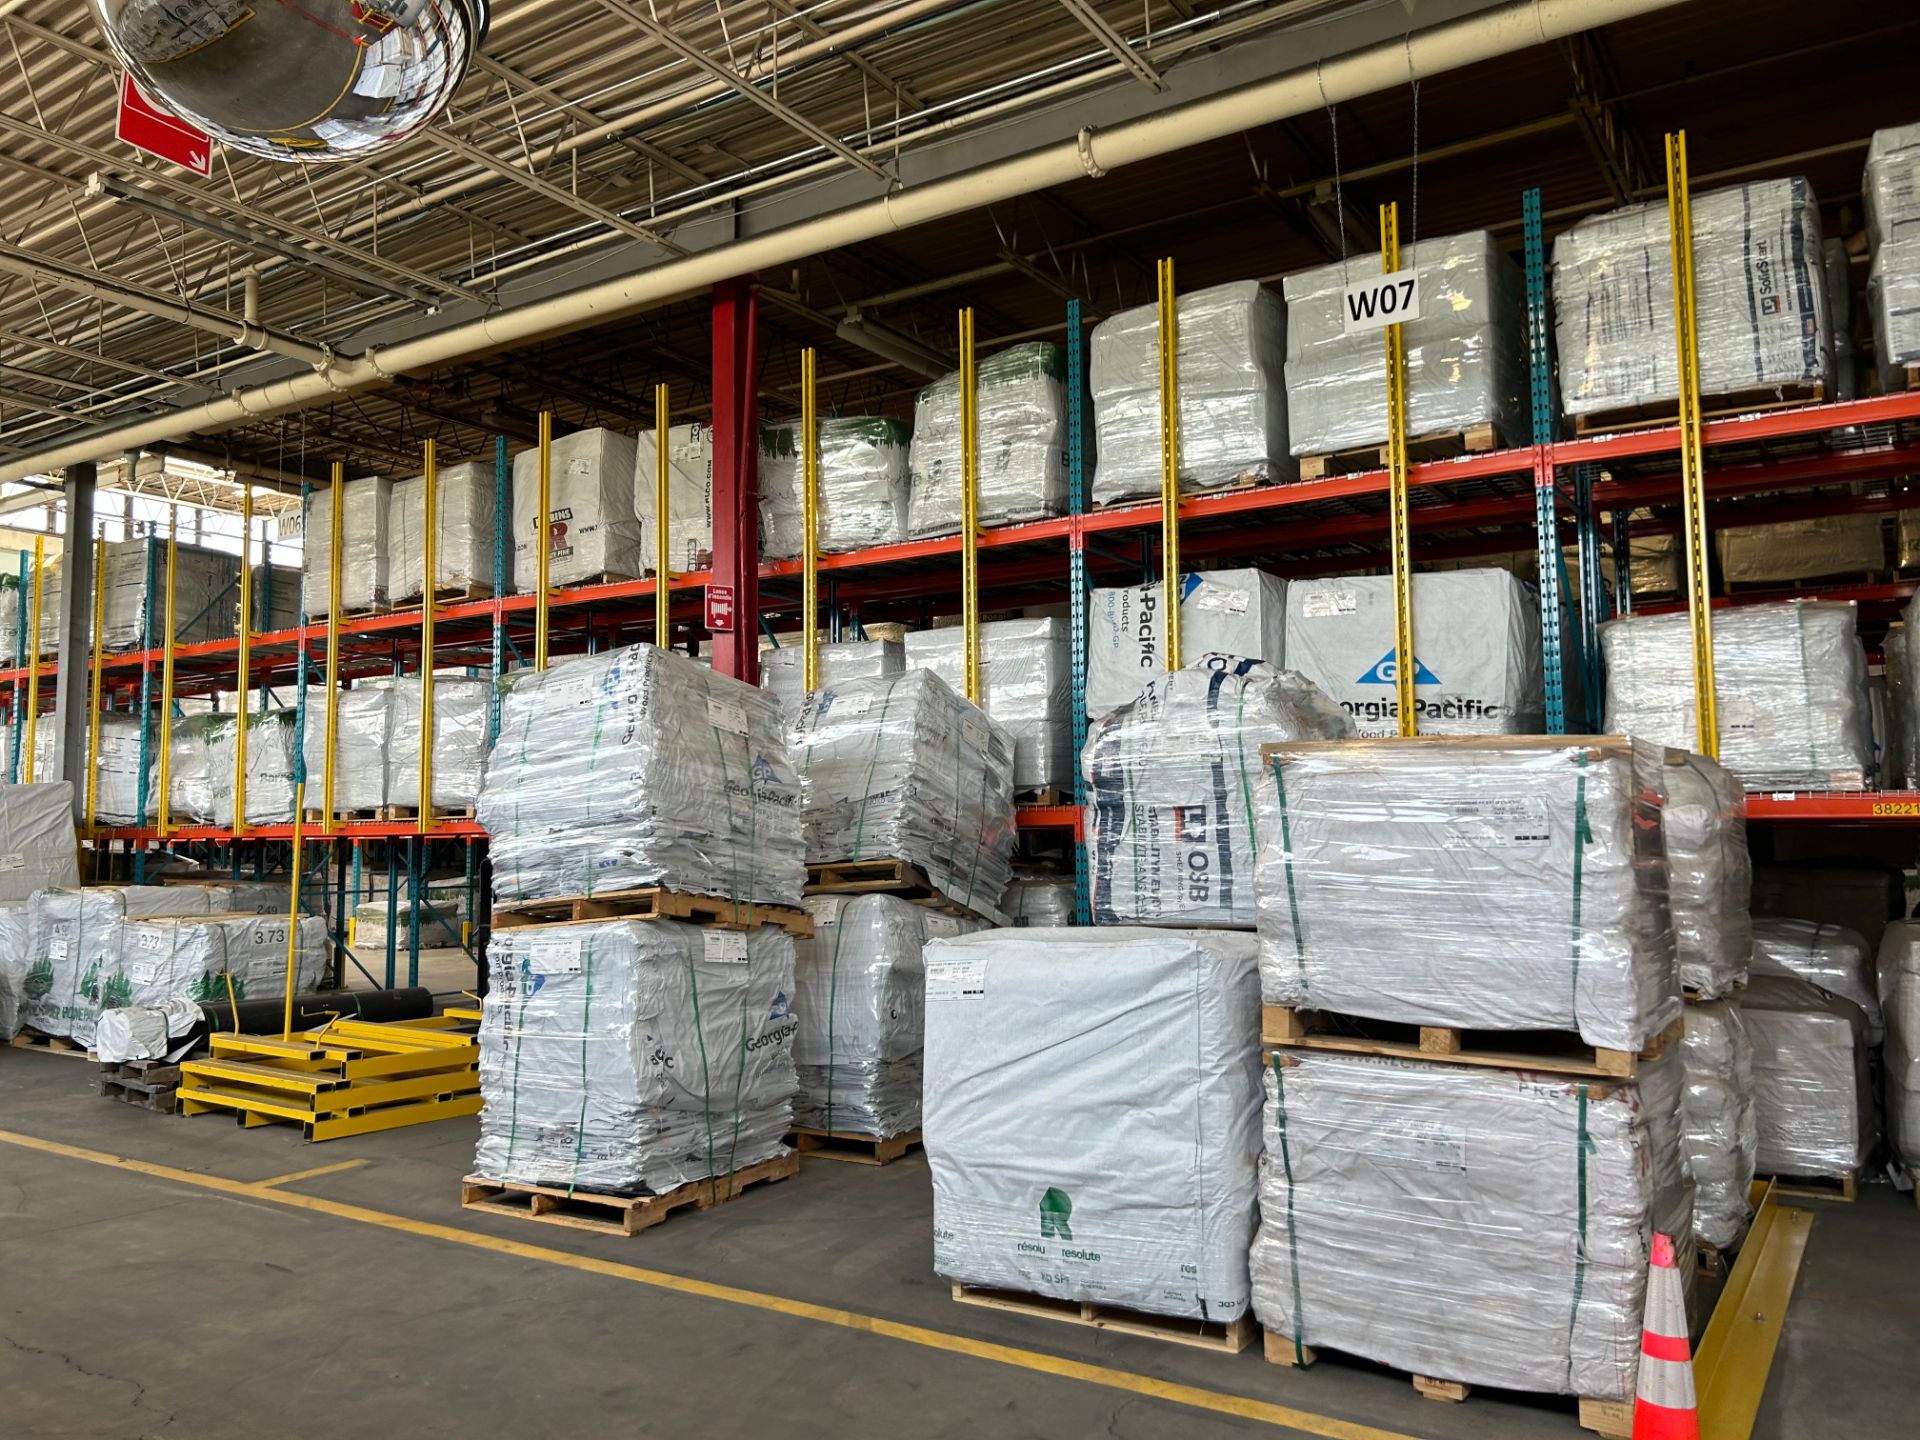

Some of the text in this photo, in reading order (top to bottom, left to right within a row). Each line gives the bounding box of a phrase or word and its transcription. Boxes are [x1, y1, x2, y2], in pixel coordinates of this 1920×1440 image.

[1348, 279, 1415, 322] W07
[279, 515, 301, 537] W06
[707, 593, 732, 601] d'incendie
[1187, 850, 1210, 903] OSB
[254, 929, 285, 945] 3.73
[1017, 1241, 1046, 1255] résolu
[1061, 1248, 1101, 1263] resolute
